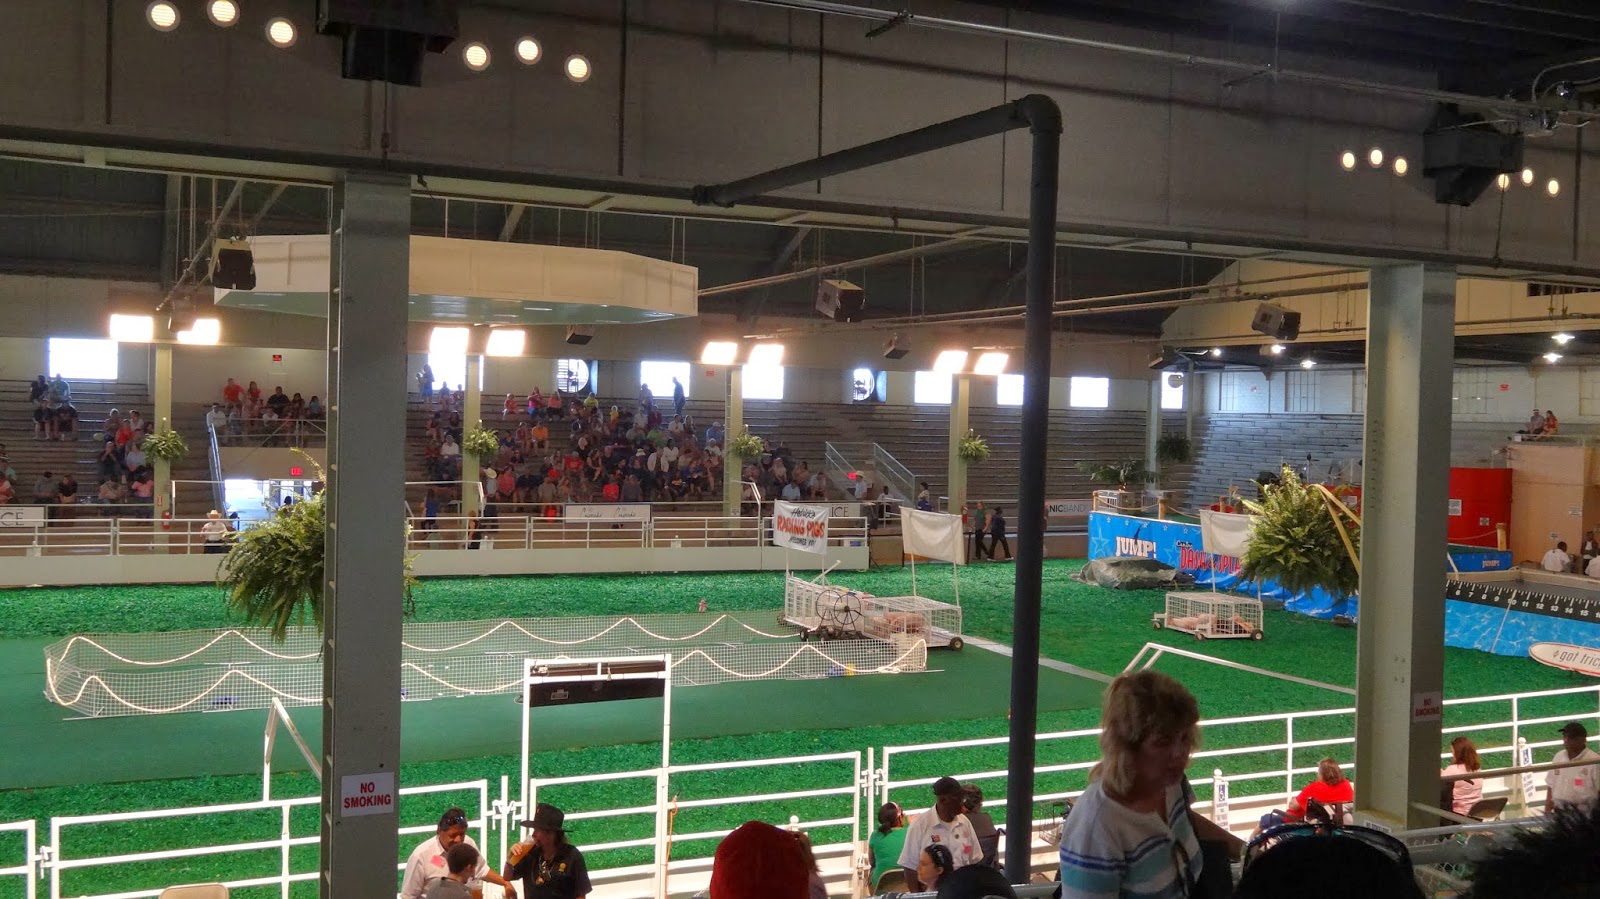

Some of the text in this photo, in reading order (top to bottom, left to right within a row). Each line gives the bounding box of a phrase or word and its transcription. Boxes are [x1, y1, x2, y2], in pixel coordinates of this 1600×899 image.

[806, 521, 825, 539] PIGS
[1115, 536, 1157, 559] JUMP!
[1181, 547, 1206, 571] DASH
[1580, 609, 1589, 617] 15
[1559, 651, 1600, 667] got tric
[360, 781, 375, 794] NO
[343, 794, 391, 809] SMOKING
